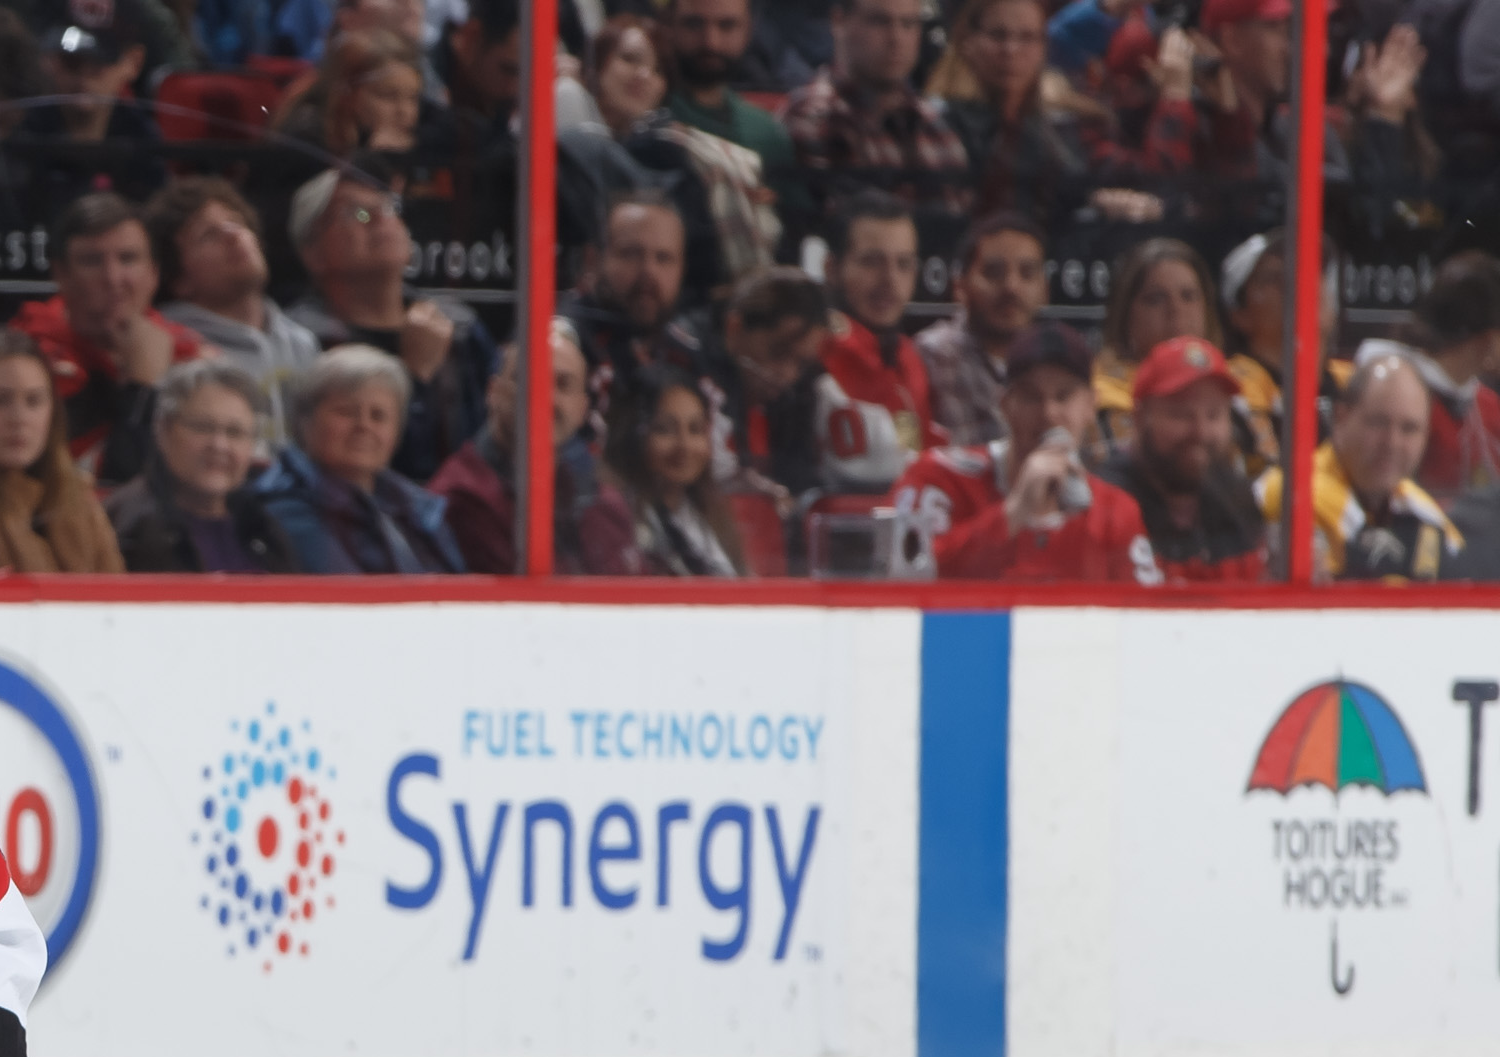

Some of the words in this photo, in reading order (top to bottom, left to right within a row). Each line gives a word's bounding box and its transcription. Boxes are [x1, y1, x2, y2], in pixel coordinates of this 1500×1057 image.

[463, 710, 555, 758] FUEL
[570, 711, 825, 761] TECHNOLOGY
[384, 752, 823, 963] Synergy
[1272, 819, 1399, 863] TOITURES
[1283, 867, 1383, 911] HOGUE
